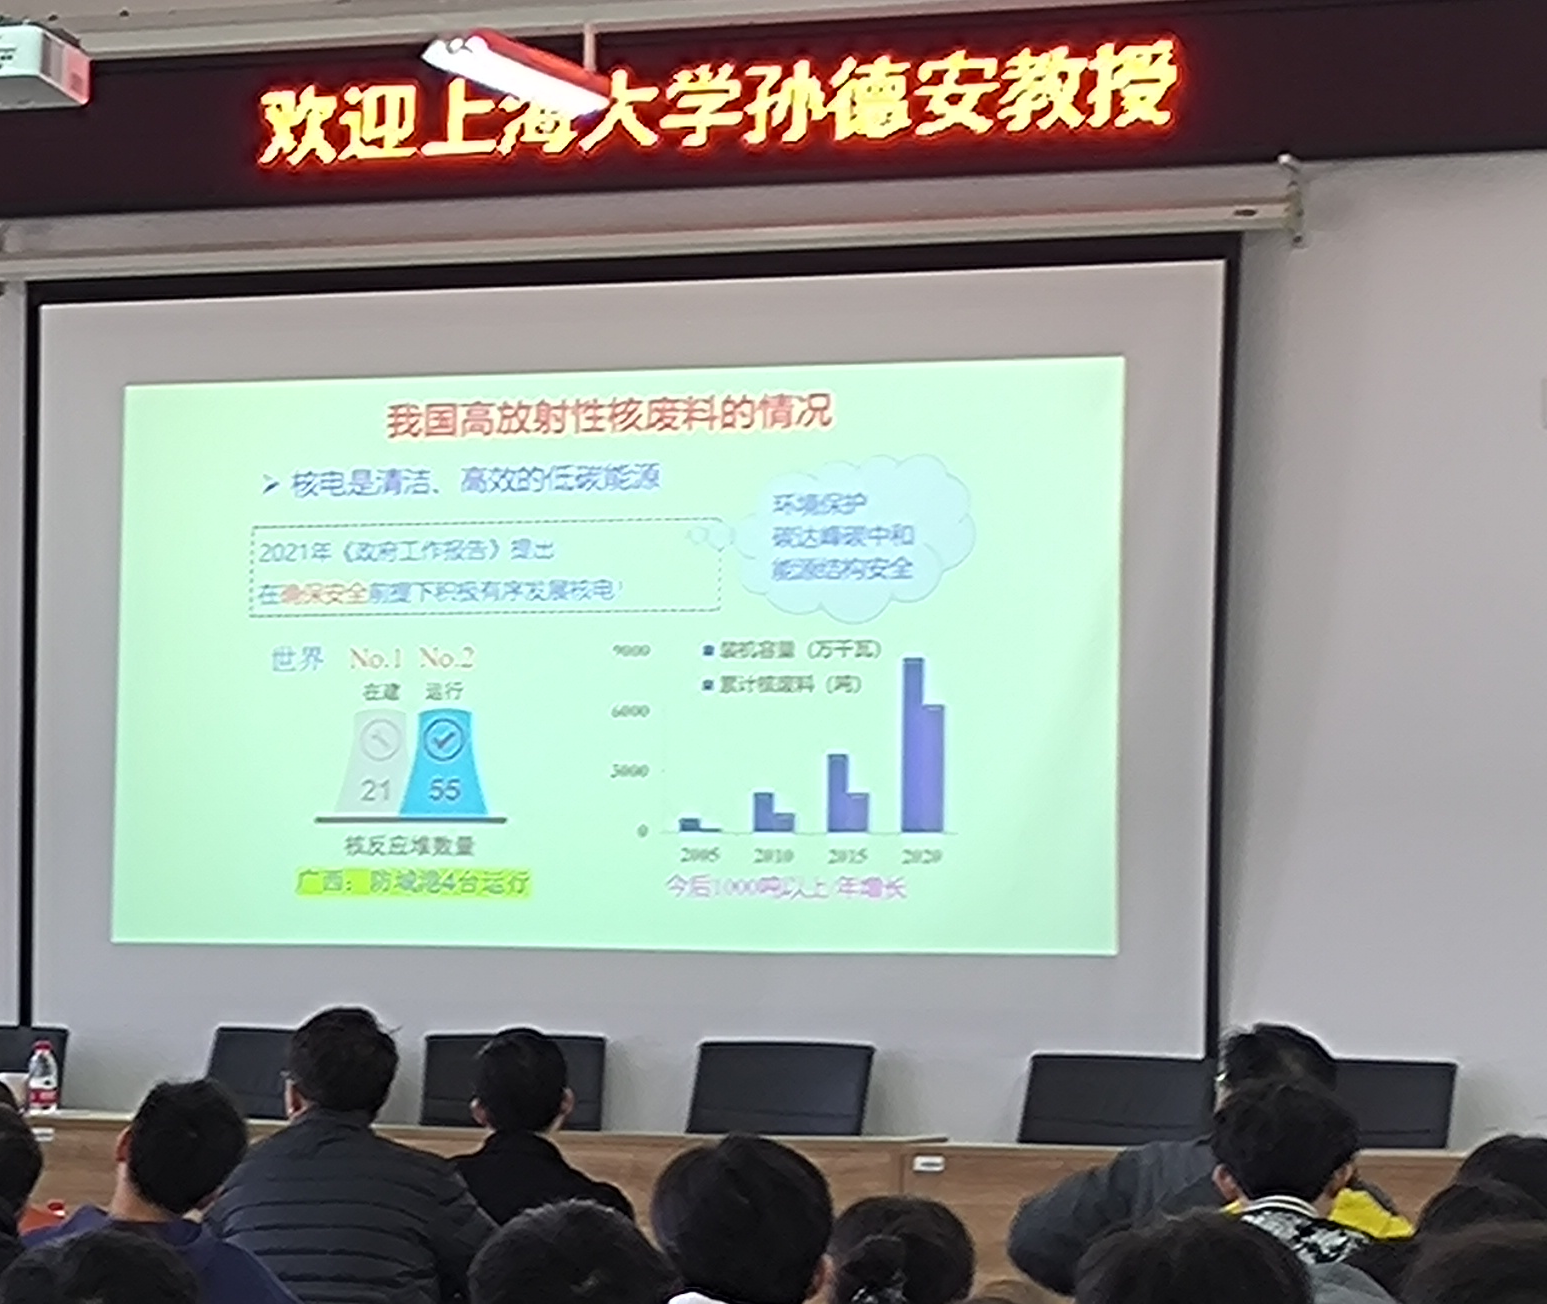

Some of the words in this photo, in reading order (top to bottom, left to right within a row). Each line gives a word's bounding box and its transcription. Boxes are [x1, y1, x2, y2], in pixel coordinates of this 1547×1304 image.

[257, 38, 1181, 168] 欢迎上海大学孙德安教授
[387, 392, 834, 440] 我国高放射性核废料的情况
[772, 491, 868, 517] 环境保护
[771, 555, 914, 582] 能源结构安全
[271, 645, 325, 673] 世界
[349, 647, 403, 670] No.1
[418, 645, 476, 669] No.2
[362, 682, 402, 701] 在建
[424, 681, 464, 701] 运行
[611, 704, 650, 719] 6000
[359, 778, 392, 802] 21
[427, 777, 462, 802] 55
[637, 823, 649, 839] 0
[343, 834, 476, 857] 核反应堆数量
[679, 847, 721, 863] 2005
[753, 847, 795, 864] 2010
[827, 847, 869, 865] 2015
[901, 847, 944, 865] 2020
